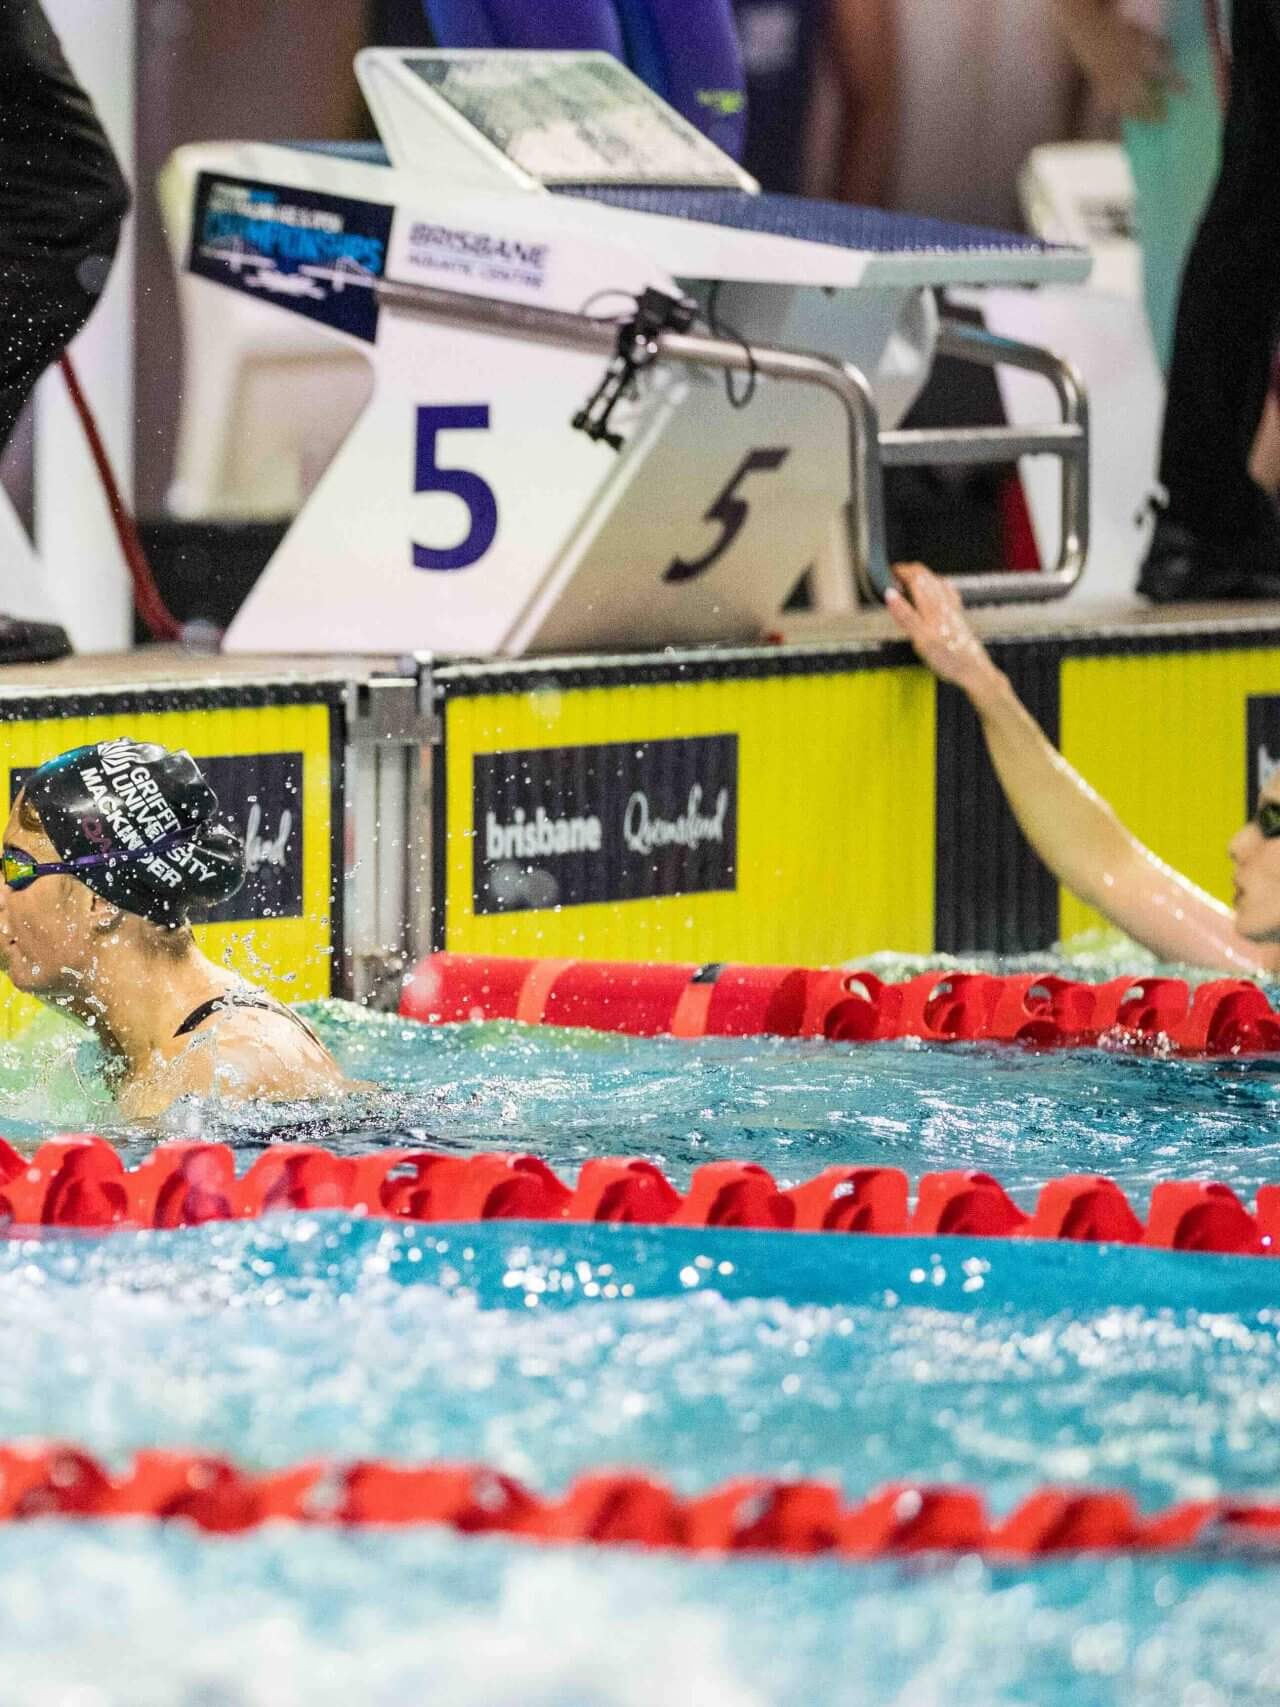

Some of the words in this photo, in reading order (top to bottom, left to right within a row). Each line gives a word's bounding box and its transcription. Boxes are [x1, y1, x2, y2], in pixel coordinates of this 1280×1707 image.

[411, 404, 498, 571] 5
[662, 447, 790, 583] 5
[130, 766, 192, 846] GRIFFI
[485, 806, 602, 859] brisbane
